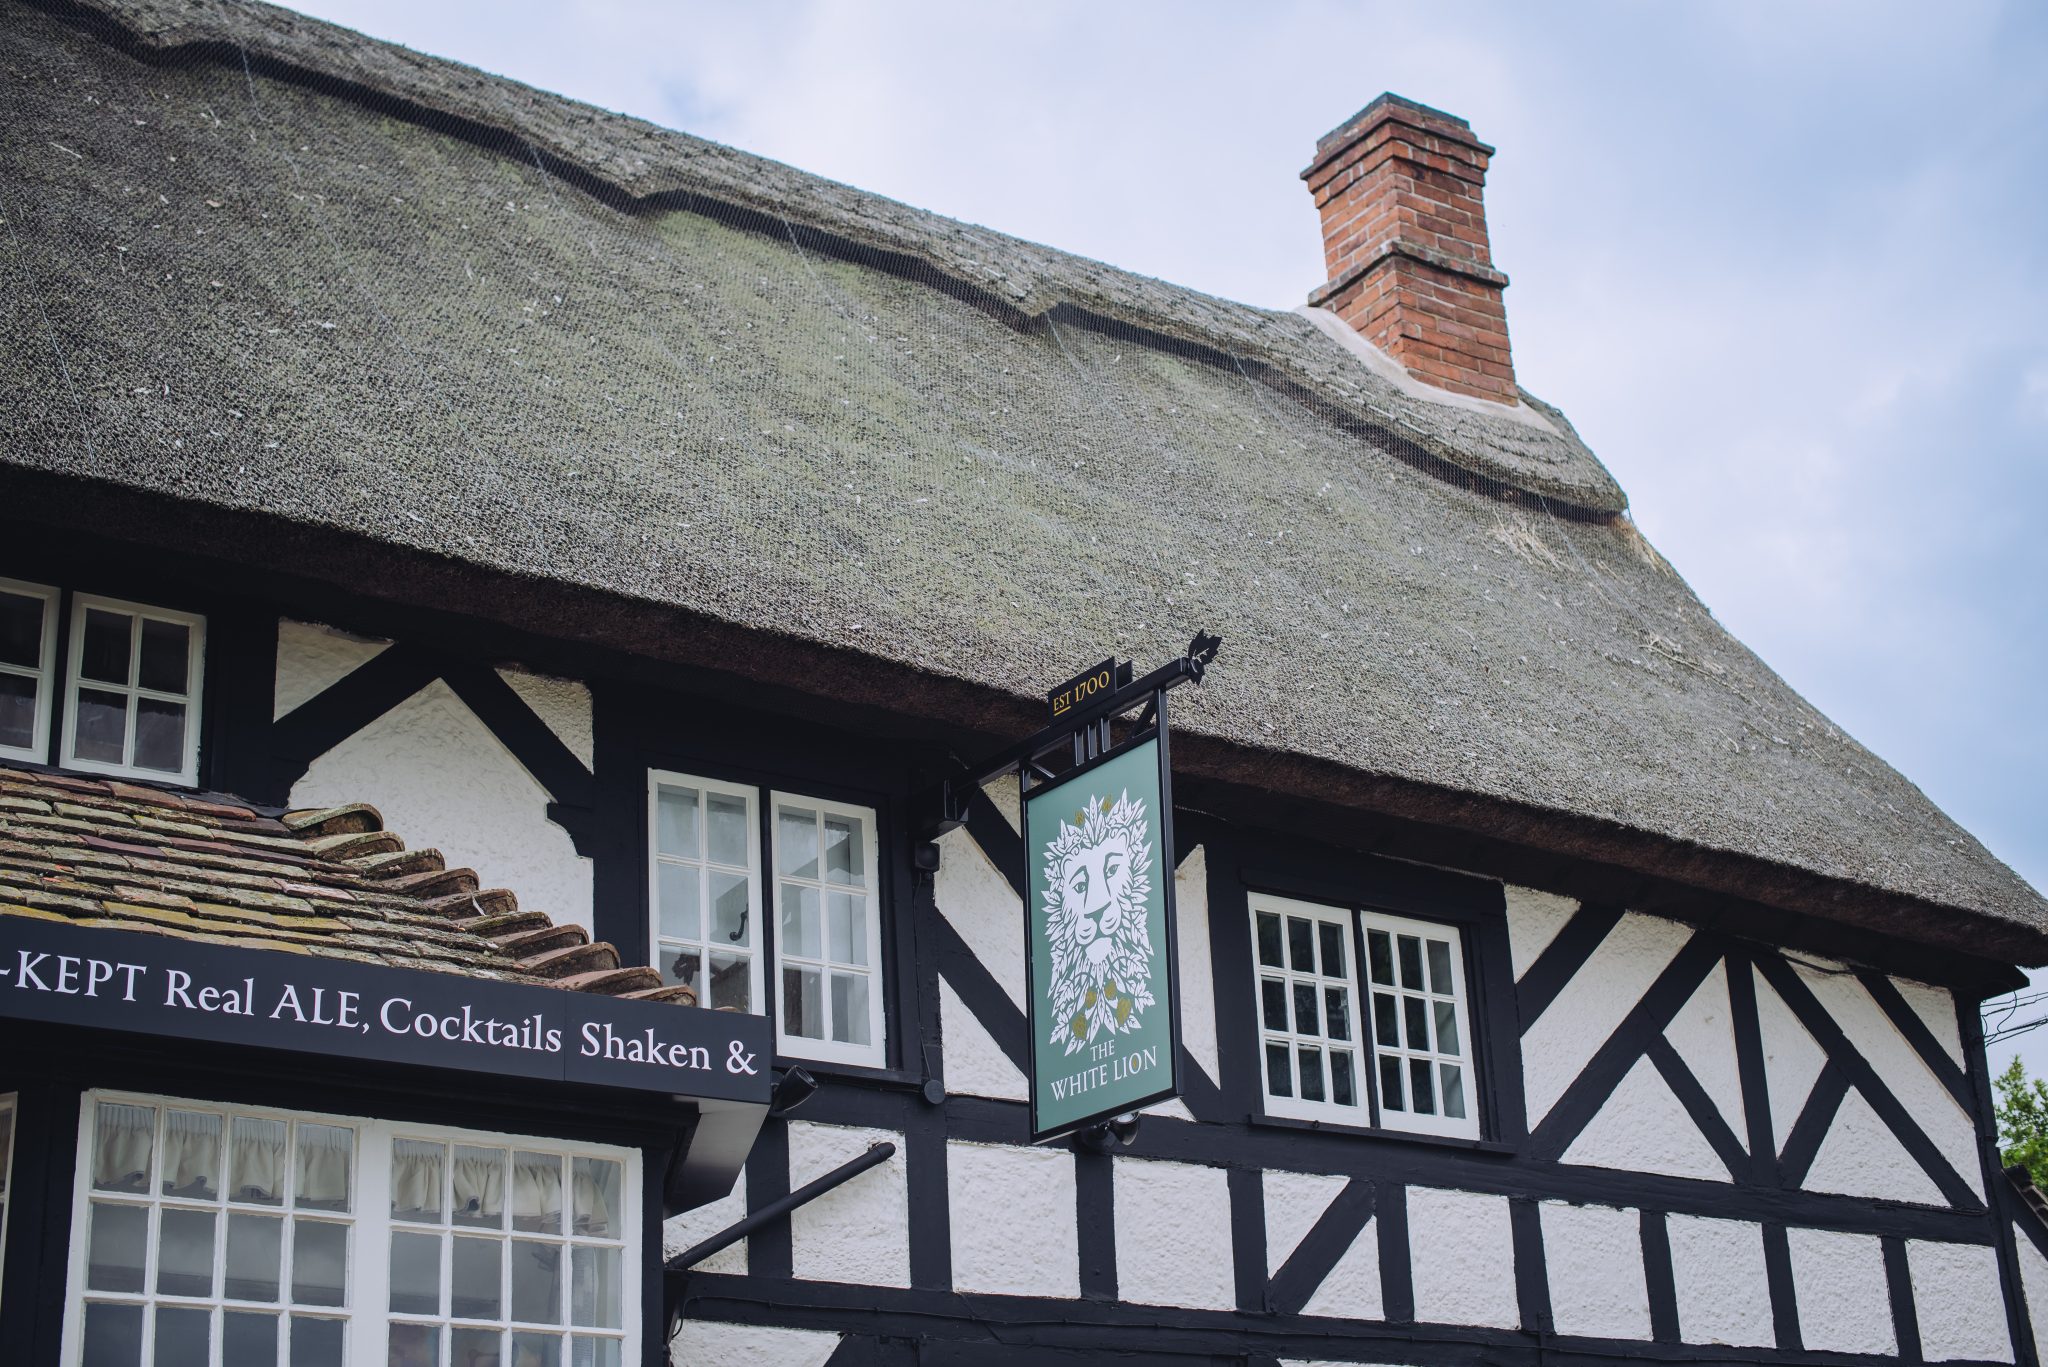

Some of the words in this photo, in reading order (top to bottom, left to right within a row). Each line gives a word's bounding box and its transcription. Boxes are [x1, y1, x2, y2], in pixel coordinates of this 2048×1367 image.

[1053, 691, 1071, 711] EST
[1074, 671, 1110, 702] 1700
[164, 969, 254, 1016] Real
[269, 984, 370, 1034] ALE,
[380, 998, 562, 1053] Cocktails
[580, 1022, 712, 1071] Shaken
[726, 1040, 758, 1075] &
[1051, 1064, 1108, 1101] WHITE
[1114, 1045, 1157, 1081] LION
[1090, 1039, 1115, 1062] THE
